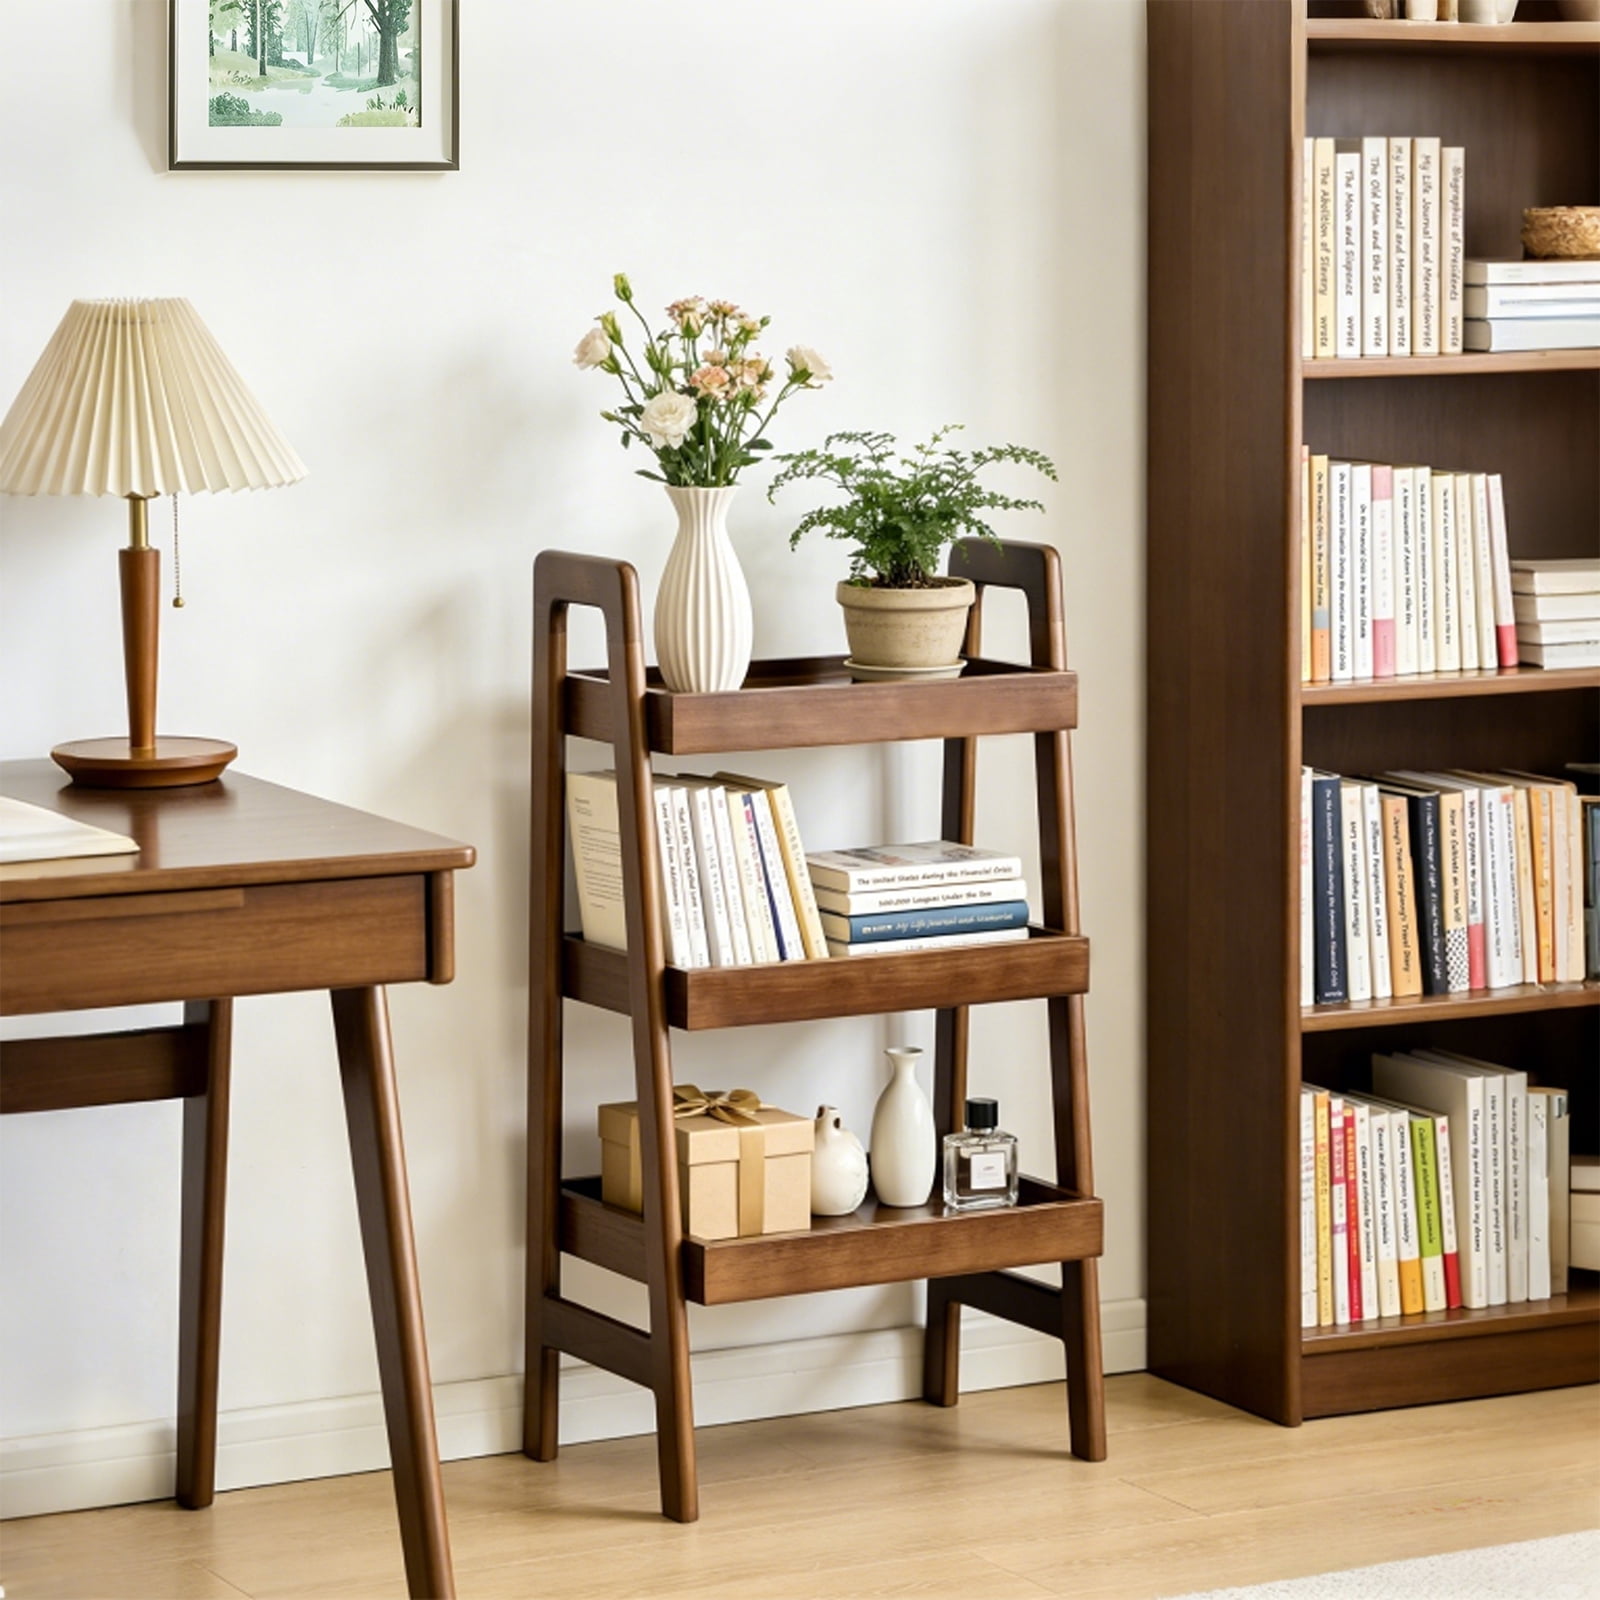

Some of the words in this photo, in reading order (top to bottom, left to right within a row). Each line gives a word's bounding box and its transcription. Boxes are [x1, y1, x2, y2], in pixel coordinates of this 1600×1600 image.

[1371, 157, 1380, 175] The
[1420, 155, 1431, 170] My
[1321, 167, 1330, 185] The
[1345, 171, 1354, 188] The
[1395, 165, 1405, 184] Life
[1422, 175, 1432, 194] Life
[1371, 180, 1381, 198] Old
[1450, 166, 1462, 227] Biographies
[1320, 189, 1330, 237] Abolition
[1345, 192, 1354, 221] Moon
[1372, 202, 1380, 225] Man
[1395, 189, 1404, 229] Journal
[1422, 198, 1432, 239] Journal
[1346, 226, 1354, 245] and
[1372, 230, 1381, 250] and
[1396, 234, 1405, 253] and
[1452, 232, 1461, 243] of
[1320, 242, 1331, 253] of
[1423, 242, 1432, 263] and
[1344, 250, 1354, 295] Sixpence
[1373, 254, 1381, 271] the
[1450, 246, 1460, 300] Presidents
[1318, 256, 1329, 295] Slavery
[1373, 276, 1382, 294] Sea
[1396, 258, 1406, 308] Memories
[1320, 316, 1328, 347] wrote
[1347, 316, 1355, 347] wrote
[1374, 317, 1382, 347] wrote
[1451, 317, 1459, 347] wrote
